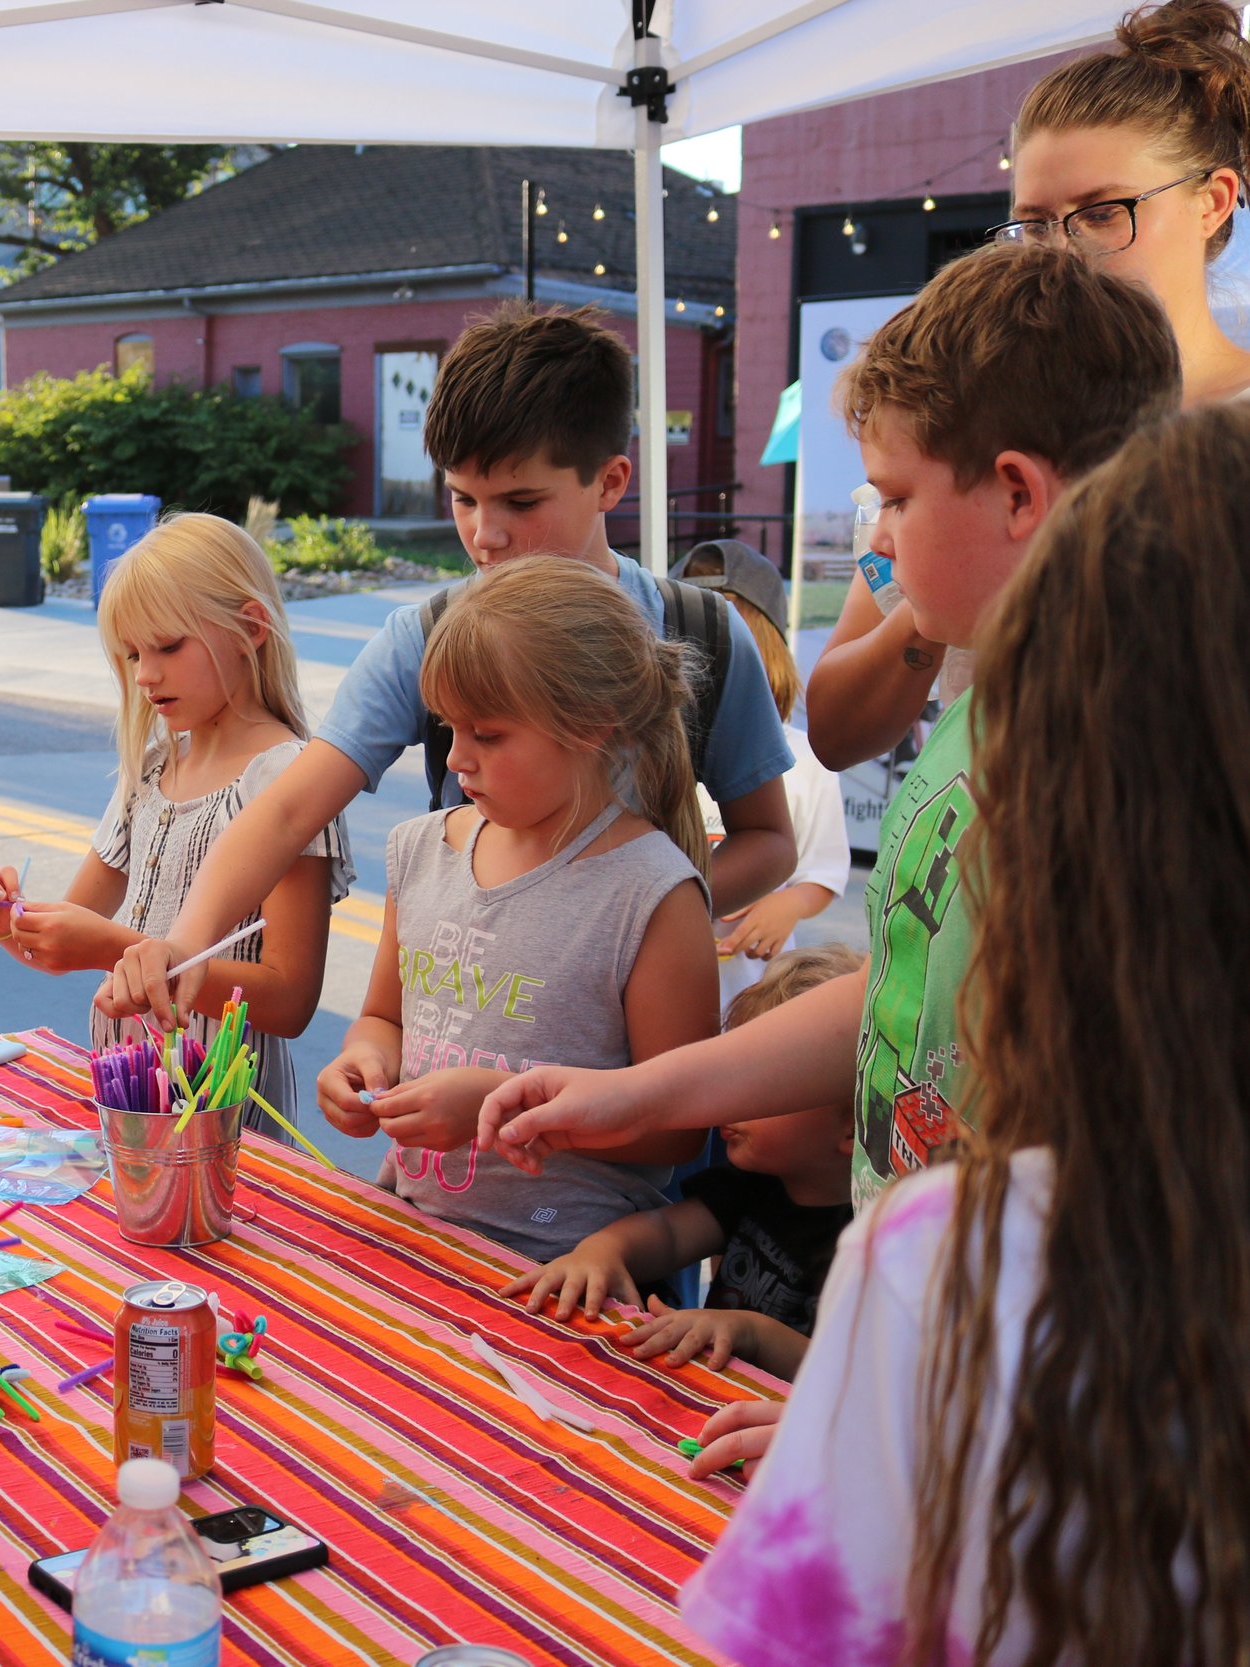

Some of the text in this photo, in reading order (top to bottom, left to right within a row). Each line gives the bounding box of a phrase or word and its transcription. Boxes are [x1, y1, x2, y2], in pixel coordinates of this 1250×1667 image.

[430, 919, 497, 977] BE
[399, 945, 546, 1024] BRAVE
[131, 1325, 178, 1336] Nutrition Facts
[130, 1347, 154, 1358] Calories
[172, 1349, 179, 1359] 0
